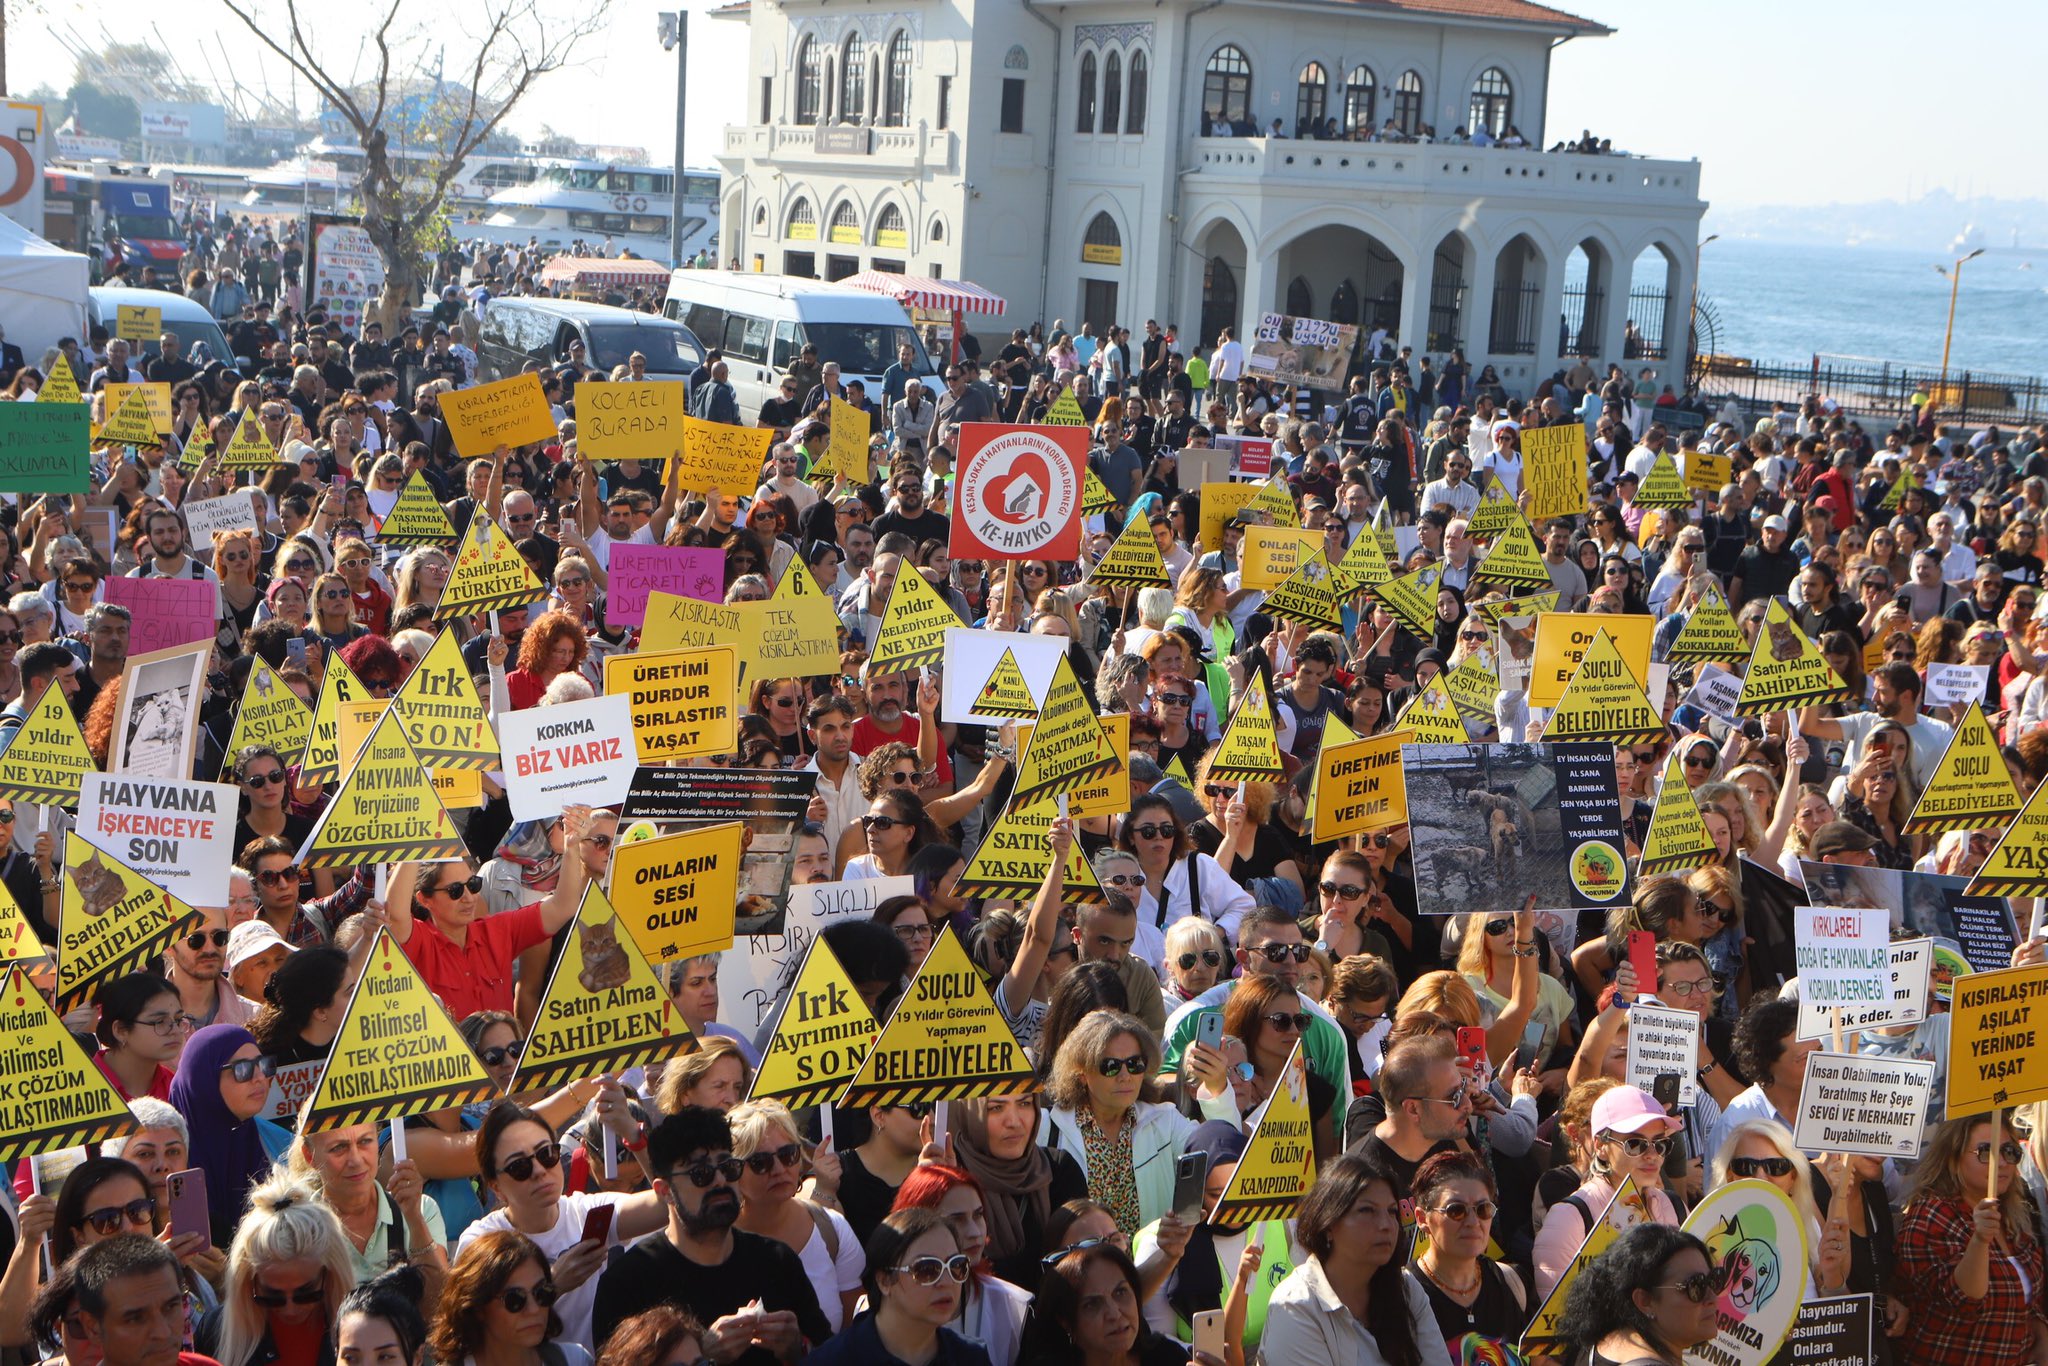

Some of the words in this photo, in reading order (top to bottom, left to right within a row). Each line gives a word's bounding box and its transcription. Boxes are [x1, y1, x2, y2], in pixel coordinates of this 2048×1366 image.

[119, 410, 149, 420] HAYVANA
[589, 416, 668, 441] BURADA
[968, 455, 989, 485] SOKAK
[985, 437, 1046, 459] HAYVANLARINI
[1044, 445, 1069, 478] KORUMA
[1532, 448, 1562, 465] KEEP
[396, 505, 424, 514] Uyutmak
[425, 504, 439, 514] değil
[393, 514, 444, 527] YAŞATMAK
[979, 520, 1052, 548] KE-HAYKO
[1360, 535, 1372, 544] 19
[1509, 526, 1527, 540] ASIL
[1110, 549, 1155, 563] BELEDİYELERİ
[1352, 547, 1378, 560] yıldır
[1503, 542, 1529, 558] SUÇLU
[457, 559, 520, 581] SAHİPLEN
[678, 556, 697, 571] VE
[1340, 560, 1387, 571] BELEDİYELER
[1482, 561, 1545, 577] BELEDİYELER
[901, 578, 919, 594] 19
[1285, 580, 1334, 604] SESSİZLERİN
[766, 610, 796, 626] TEK
[893, 597, 934, 621] yıldır
[1694, 606, 1729, 618] Avrupa
[881, 613, 956, 638] BELEDİYELER
[1684, 628, 1711, 638] FARE
[1711, 628, 1739, 638] DOLU
[880, 639, 903, 657] NE
[633, 658, 709, 682] ÜRETİMİ
[1583, 660, 1623, 682] SUÇLU
[1752, 663, 1788, 678] Satın
[1789, 657, 1823, 672] Alma
[417, 669, 465, 697] Irk
[1002, 675, 1020, 686] KANLI
[1570, 685, 1579, 694] 19
[1580, 684, 1602, 693] Yıldır
[1603, 681, 1636, 693] Görevini
[632, 685, 710, 706] DURDUR
[1589, 694, 1631, 706] Yapmayan
[43, 704, 64, 720] 19
[394, 697, 484, 722] Ayrımına
[1556, 702, 1650, 728] BELEDİYELER
[536, 718, 595, 741] KORKMA
[1036, 723, 1071, 743] Uyutmak
[1072, 713, 1091, 730] değil
[1236, 717, 1271, 730] HAYVAN
[1406, 713, 1459, 730] HAYVAN
[28, 728, 75, 747] yıldır
[643, 732, 700, 751] YAŞAT
[1031, 728, 1097, 762] YAŞATMAK
[1236, 735, 1267, 752] YAŞAM
[1960, 724, 1986, 748] ASIL
[8, 748, 92, 768] BELEDİYELER
[372, 743, 406, 761] İnsana
[515, 744, 553, 777] BİZ
[555, 737, 623, 770] VARIZ
[1557, 755, 1566, 763] EY
[1566, 753, 1589, 763] İNSAN
[1590, 752, 1612, 762] OĞLU
[3, 764, 28, 782] NE
[1331, 750, 1401, 778] ÜRETİME
[1570, 769, 1579, 778] AL
[1580, 769, 1601, 778] SANA
[1953, 755, 1990, 781] SUÇLU
[356, 766, 423, 791] HAYVANA
[1347, 778, 1380, 798] İZİN
[1974, 779, 2010, 791] Yapmayan
[98, 781, 217, 814] HAYVANA
[1075, 786, 1109, 800] VERİR
[1922, 793, 2016, 814] BELEDİYELER
[353, 794, 420, 819] Yeryüzüne
[1335, 798, 1389, 823] VERME
[1560, 799, 1576, 809] SEN
[1576, 799, 1594, 810] YAŞA
[1595, 799, 1604, 808] BU
[1605, 798, 1619, 808] PİS
[1682, 808, 1696, 819] değil
[97, 807, 215, 841] İŞKENCEYE
[1579, 814, 1603, 823] YERDE
[1568, 827, 1620, 840] YAŞABİLİRSEN
[1653, 820, 1702, 840] YAŞATMAK
[128, 837, 179, 864] SON
[993, 832, 1051, 858] SATIŞ
[635, 853, 718, 885] ONLARIN
[653, 878, 696, 906] SESİ
[811, 884, 878, 917] SUÇLU
[65, 915, 111, 952] Satın
[112, 888, 155, 922] Alma
[646, 906, 698, 931] OLUN
[1812, 912, 1862, 938] KIRKLARELİ
[1797, 942, 1819, 969] DOĞA
[1819, 947, 1830, 969] VE
[1830, 947, 1890, 970] HAYVANLARI
[365, 971, 413, 997] Vicdani
[917, 971, 976, 1006] SUÇLU
[1807, 978, 1839, 1001] KORUMA
[1839, 973, 1885, 1001] DERNEĞİ
[385, 1000, 400, 1011] Ve
[548, 994, 600, 1021] Satın
[607, 983, 657, 1010] Alma
[796, 981, 850, 1023] Irk
[360, 1006, 428, 1042] Bilimsel
[896, 1010, 911, 1023] 19
[914, 1007, 945, 1022] Yıldır
[946, 1004, 996, 1020] Görevini
[1633, 1013, 1642, 1025] Bir
[1859, 1010, 1894, 1025] eder.
[1978, 1006, 2031, 1034] AŞILAT
[17, 1035, 34, 1047] Ve
[773, 1017, 877, 1057] Ayrımına
[925, 1023, 987, 1040] Yapmayan
[1636, 1033, 1644, 1042] ve
[1644, 1031, 1663, 1044] ahlaki
[345, 1047, 381, 1069] TEK
[383, 1035, 448, 1063] ÇÖZÜM
[1971, 1030, 2036, 1058] YERİNDE
[873, 1039, 1014, 1083] BELEDİYELER
[1638, 1049, 1670, 1062] hayvanlara
[1670, 1050, 1685, 1063] olan
[328, 1053, 472, 1101] KISIRLAŞTIRMADIR
[1811, 1061, 1839, 1081] İnsan
[1841, 1065, 1901, 1085] Olabilmenin
[1978, 1057, 2026, 1083] YAŞAT
[17, 1069, 86, 1102] ÇÖZÜM
[1818, 1085, 1868, 1106] Yaratılmış
[1869, 1089, 1887, 1104] Her
[1888, 1090, 1914, 1109] Şeye
[1808, 1103, 1841, 1122] SEVGİ
[1841, 1108, 1855, 1123] VE
[1858, 1110, 1916, 1128] MERHAMET
[1260, 1120, 1309, 1139] BARINAKLAR
[1822, 1127, 1893, 1146] Duyabilmektir.
[1271, 1141, 1305, 1164] ÖLÜM
[1799, 1302, 1860, 1321] hayvanlar
[1793, 1340, 1835, 1359] Onlara
